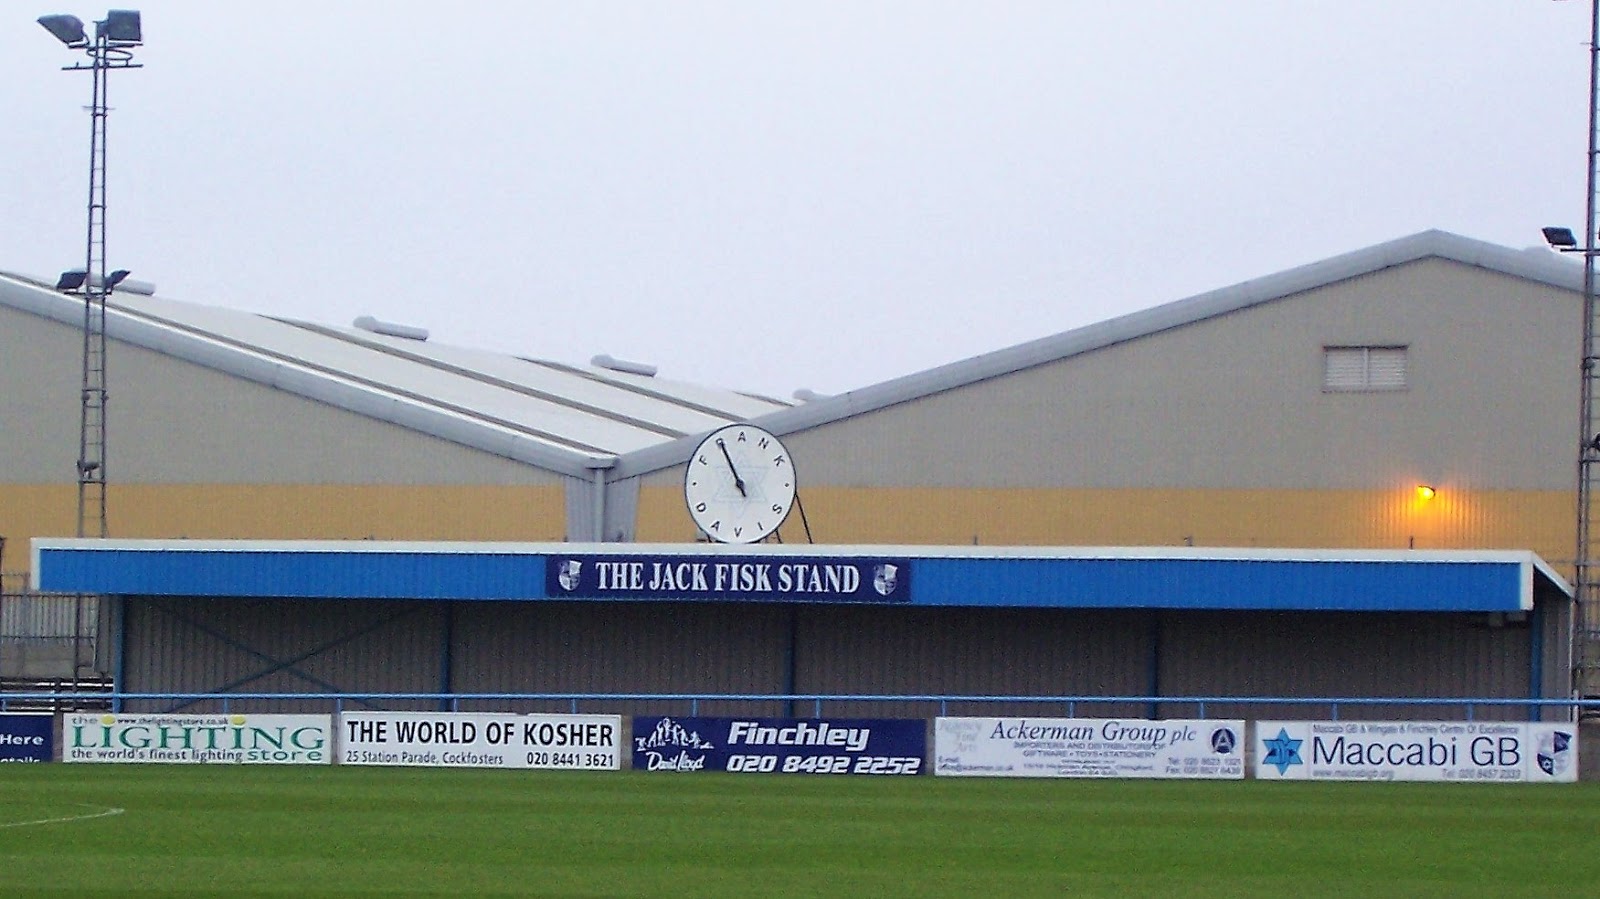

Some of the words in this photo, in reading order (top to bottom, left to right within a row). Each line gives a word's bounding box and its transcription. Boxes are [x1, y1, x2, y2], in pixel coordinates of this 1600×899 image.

[696, 503, 783, 537] DAVIS
[595, 562, 644, 590] THE
[649, 563, 709, 591] JACK
[713, 563, 773, 592] FISK
[777, 564, 860, 593] STAND
[0, 733, 44, 745] Here
[347, 721, 387, 743] THE
[395, 722, 477, 745] WORLD
[486, 722, 515, 745] OF
[523, 723, 613, 747] KOSHER
[727, 721, 870, 751] Finchley
[989, 721, 1095, 741] Ackerman
[1102, 721, 1167, 749] Group
[1171, 725, 1197, 745] plc
[1014, 741, 1065, 749] IMPORTERS
[71, 749, 93, 759] the
[97, 749, 145, 760] world's
[149, 749, 186, 760] finest
[192, 749, 242, 762] lighting
[247, 750, 322, 761] store
[346, 751, 359, 762] 25
[362, 751, 398, 763] Station
[443, 751, 503, 765] Cockfosters
[527, 752, 548, 766] 020
[552, 752, 580, 766] 8441
[585, 753, 614, 767] 3621
[1023, 750, 1067, 758] GIFTWARE
[1075, 750, 1099, 758] TOYS
[1103, 750, 1157, 759] STATIONERY
[1313, 736, 1456, 766] Maccabi
[1471, 736, 1521, 766] GB
[726, 755, 777, 773] 020
[782, 756, 851, 774] 8492
[854, 757, 921, 775] 2252
